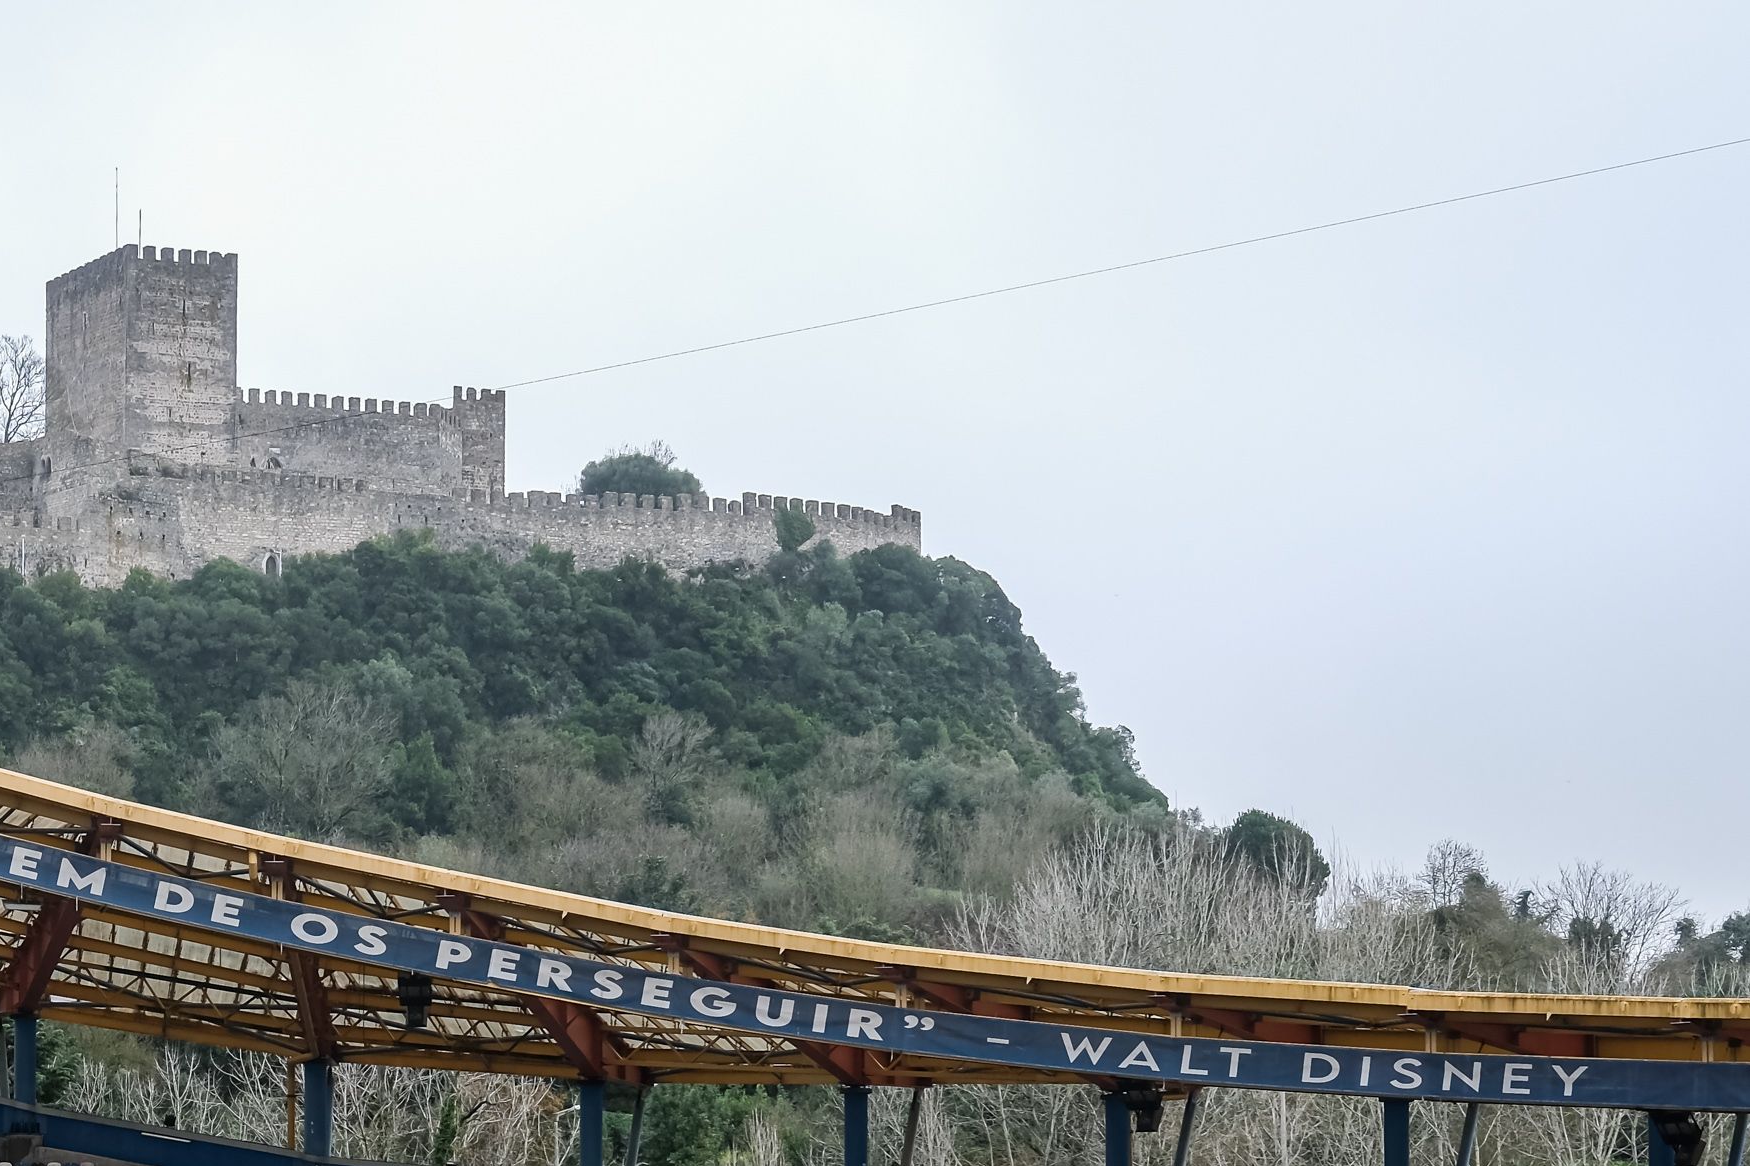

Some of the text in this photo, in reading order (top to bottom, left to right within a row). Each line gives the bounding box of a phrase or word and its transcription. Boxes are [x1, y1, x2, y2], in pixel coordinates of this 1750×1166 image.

[153, 881, 244, 928] DE
[290, 914, 389, 956] OS
[1060, 1032, 1252, 1079] WALT
[1301, 1053, 1589, 1098] DISNEY
